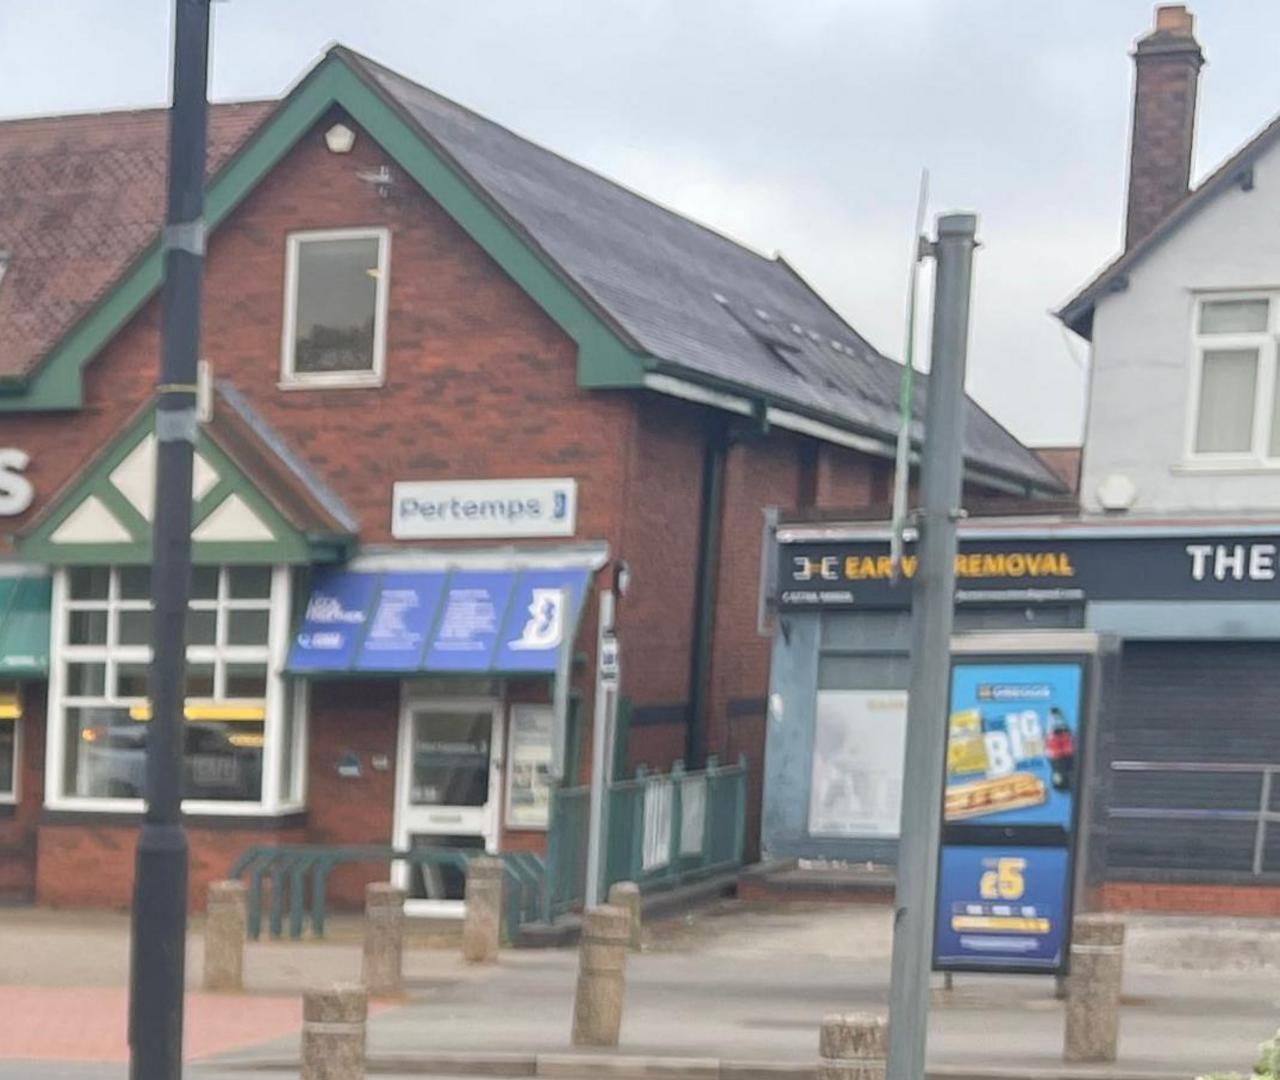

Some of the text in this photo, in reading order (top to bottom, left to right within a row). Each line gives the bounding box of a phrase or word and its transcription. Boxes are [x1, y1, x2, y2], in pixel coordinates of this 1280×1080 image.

[399, 496, 541, 522] Pertemps
[844, 556, 892, 580] EAR
[953, 552, 1075, 577] REMOVAL
[1185, 544, 1277, 581] THE
